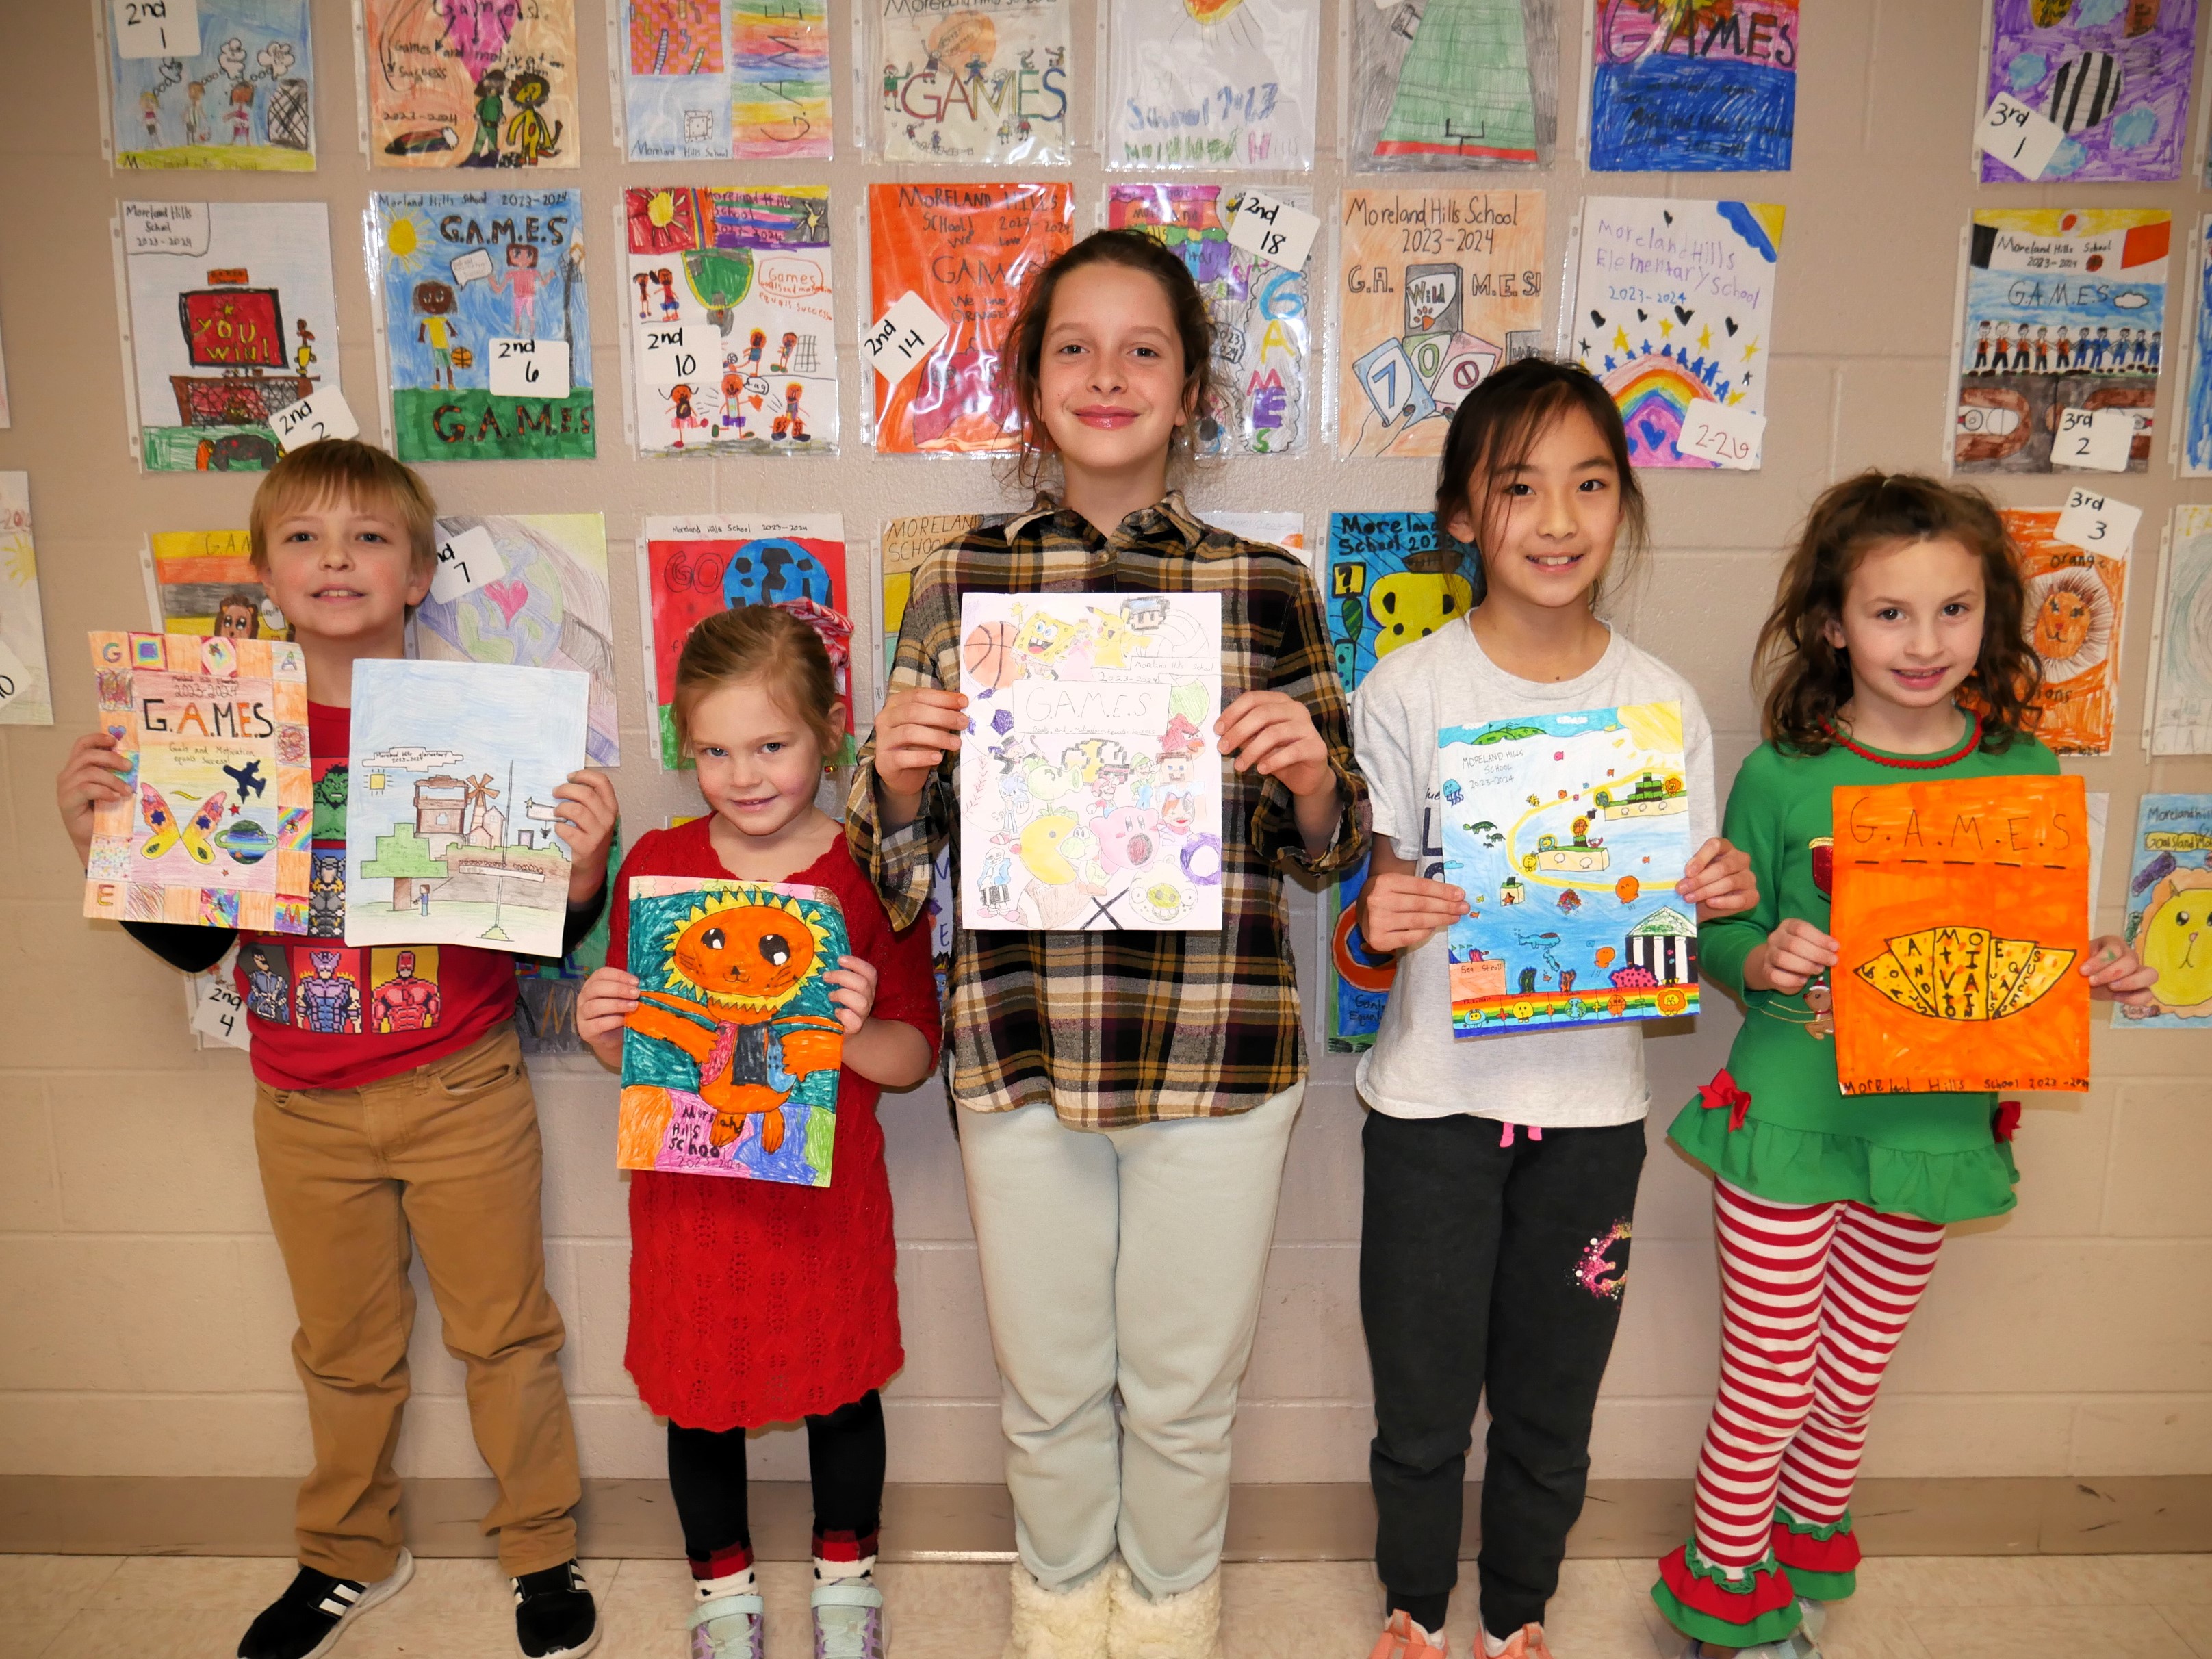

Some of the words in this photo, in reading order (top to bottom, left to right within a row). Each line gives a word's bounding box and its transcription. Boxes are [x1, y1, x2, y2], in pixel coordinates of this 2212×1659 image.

[126, 0, 166, 25] 2nd
[159, 27, 166, 49] 1
[901, 67, 1068, 123] GAMES
[1991, 103, 2029, 127] 3rd
[1244, 196, 1280, 226] 2nd
[1346, 195, 1426, 227] Moreland
[1430, 197, 1461, 225] Hills
[1465, 194, 1517, 227] School
[1261, 231, 1287, 255] 18
[1402, 228, 1494, 254] 2023-2024
[1599, 219, 1687, 259] Moreland
[1692, 240, 1736, 270] Hills
[1997, 235, 2051, 254] Moreland
[2054, 243, 2074, 254] Hills
[2083, 240, 2112, 253] School
[769, 268, 815, 285] Games
[1597, 247, 1710, 291] Elementary
[1712, 275, 1761, 310] School
[1609, 285, 1687, 305] 2023-2024
[194, 318, 256, 343] YOU
[647, 327, 683, 350] 2nd
[864, 319, 897, 357] 2nd
[498, 339, 535, 358] 2nd
[898, 329, 925, 358] 14
[526, 361, 539, 383] 6
[676, 354, 697, 377] 10
[1373, 360, 1396, 408] 7
[279, 400, 313, 435] 2nd
[2063, 412, 2094, 432] 3rd
[312, 422, 331, 441] 2
[2075, 437, 2091, 456] 2
[2070, 491, 2105, 512] 3rd
[672, 525, 701, 534] Moreland
[707, 525, 722, 533] Hills
[728, 523, 751, 534] School
[886, 513, 985, 541] MORELAND
[2087, 521, 2108, 540] 3
[1135, 659, 1167, 669] Moreland
[1193, 663, 1214, 672] School
[1098, 671, 1157, 683] 2023-2024
[1463, 751, 1504, 769] MORELAND
[1506, 749, 1523, 758] HILLS
[1484, 764, 1513, 775] SCHOOL
[1469, 775, 1515, 789] 2023-2024
[1461, 966, 1474, 974] Sea
[220, 1014, 234, 1036] 4
[1928, 1078, 1964, 1092] Hills
[1984, 1077, 2019, 1090] School
[673, 1122, 701, 1140] Hills
